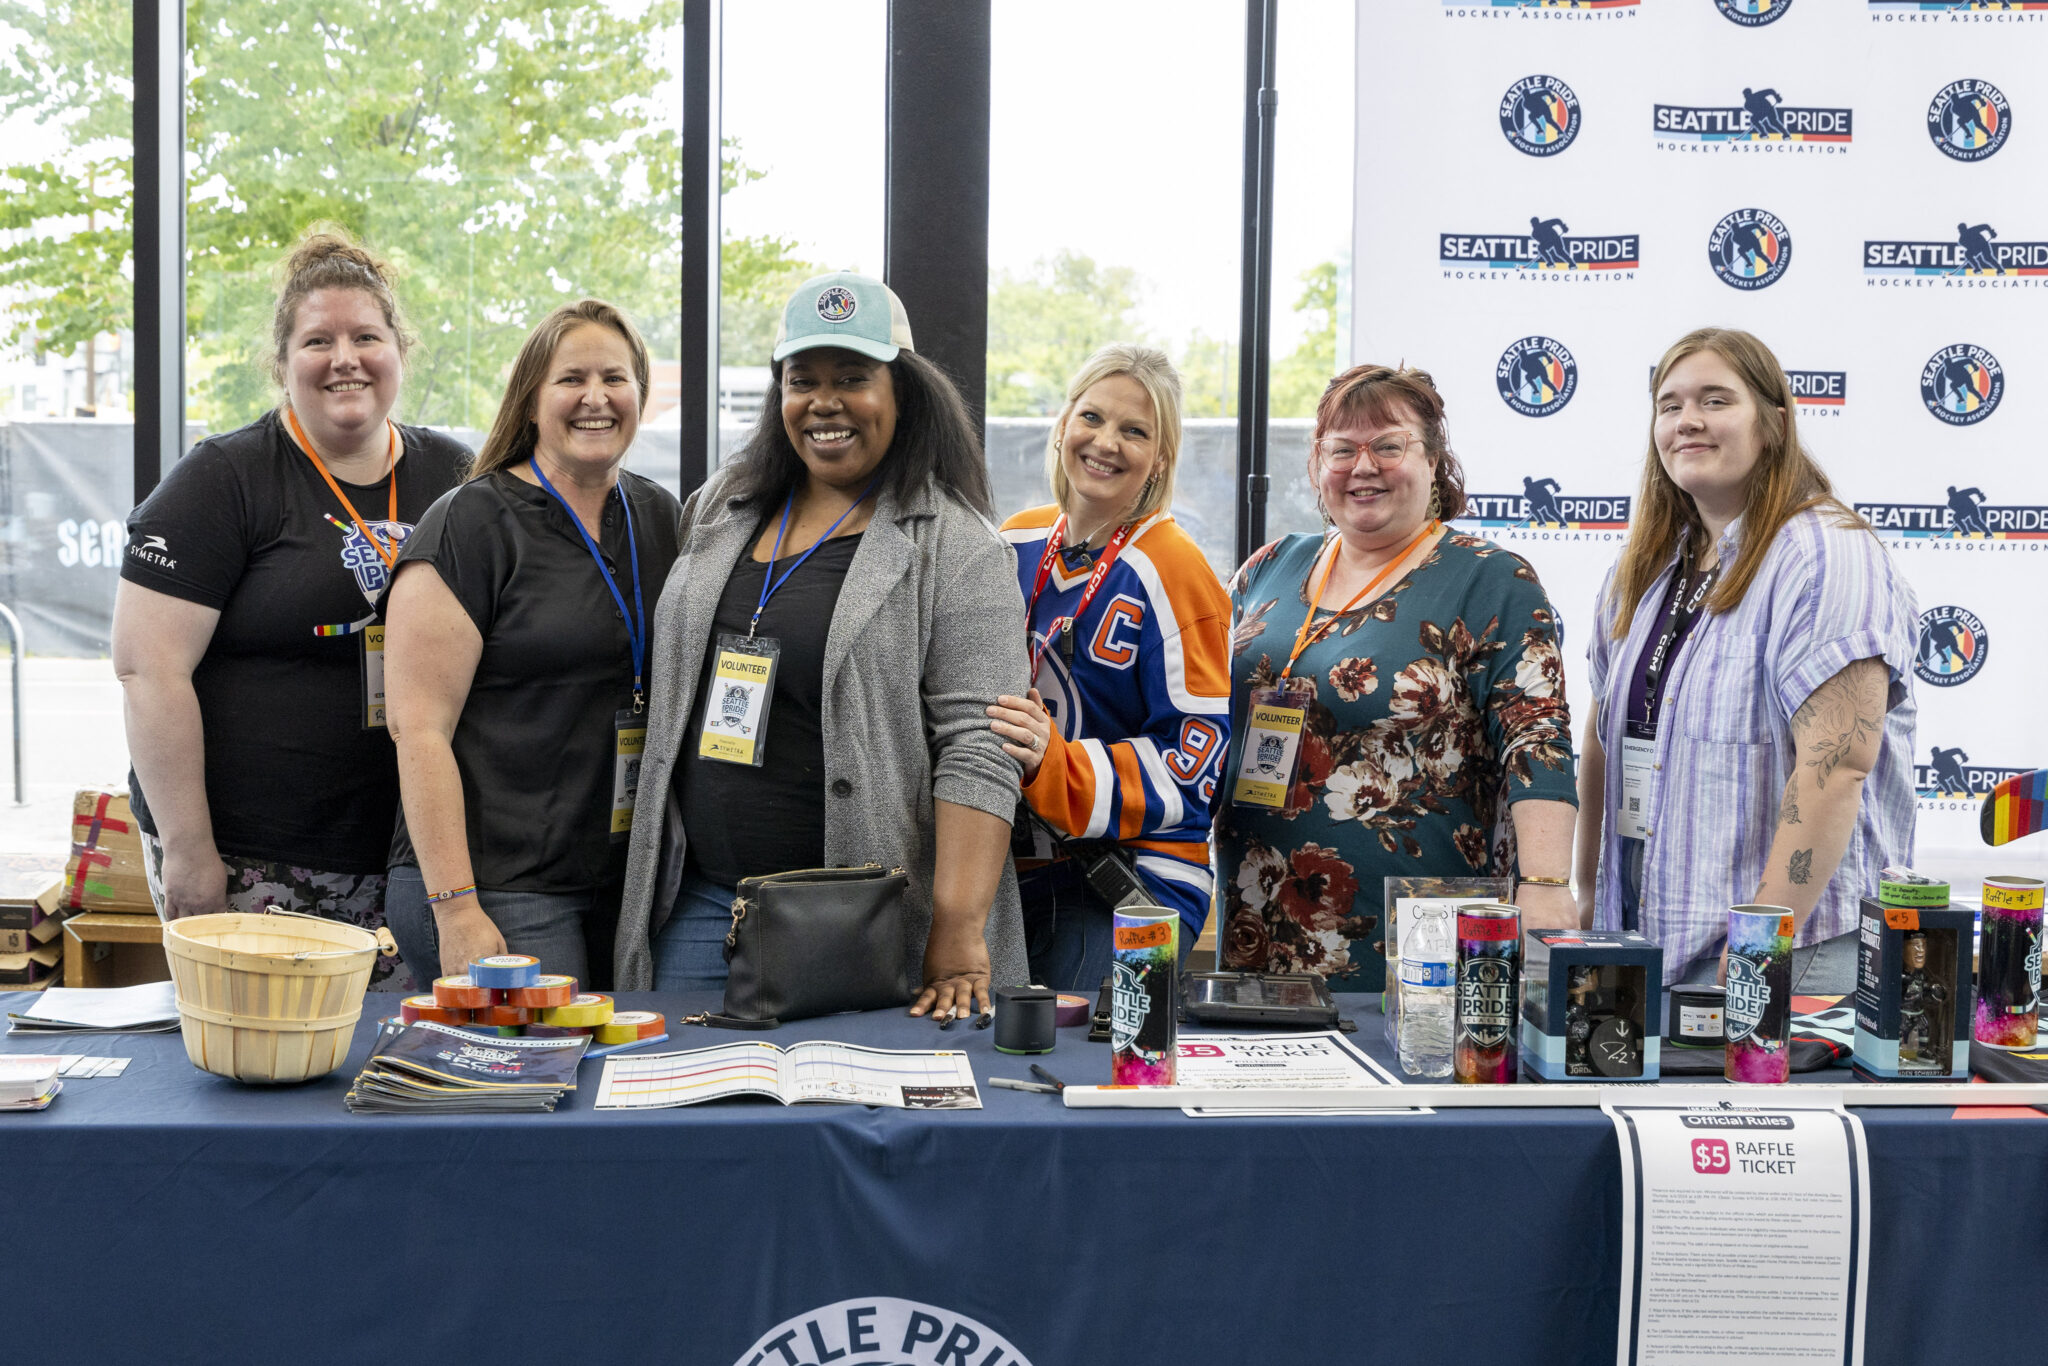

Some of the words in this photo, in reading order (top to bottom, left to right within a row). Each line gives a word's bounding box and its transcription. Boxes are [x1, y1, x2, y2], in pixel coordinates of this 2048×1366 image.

[1446, 9, 1511, 19] HOCKEY
[1521, 9, 1637, 20] ASSOCIATION
[1726, 9, 1757, 24] HOCKEY
[1759, 0, 1789, 24] ASSOCIA
[1872, 14, 1939, 22] HOCKEY
[1951, 14, 2044, 22] ASSOCIATI
[1501, 76, 1542, 118] SEATTLE
[1545, 77, 1578, 109] PRIDE
[1928, 80, 1971, 123] SEATTLE
[1975, 81, 2008, 112] PRIDE
[1657, 108, 1752, 131] SEATTLE
[1784, 111, 1847, 132] PRIDE
[1514, 138, 1544, 154] HOCKEY
[1546, 113, 1577, 153] ASSOCIATION
[1942, 143, 1973, 159] HOCKEY
[1975, 117, 2008, 158] ASSOCIATION
[1658, 142, 1720, 153] HOCKEY
[1731, 145, 1847, 154] ASSOCIATION
[1710, 210, 1752, 252] SEATTLE
[1755, 210, 1788, 241] PRIDE
[1443, 237, 1540, 259] SEATTLE
[1569, 239, 1635, 260] PRIDE
[1867, 244, 1966, 266] SEATTLE
[1997, 246, 2048, 266] PRID
[1443, 271, 1509, 280] HOCKEY
[1519, 272, 1634, 282] ASSOCIATION
[1723, 272, 1754, 288] HOCKEY
[1756, 246, 1788, 287] ASSOCIATION
[1868, 279, 1934, 287] HOCKEY
[1498, 337, 1539, 378] SEATTLE
[1542, 339, 1574, 369] PRIDE
[1922, 345, 1964, 387] SEATTLE
[1968, 346, 2001, 377] PRIDE
[1510, 398, 1540, 414] HOCKEY
[1541, 374, 1574, 414] ASSOCIATION
[1934, 407, 1964, 422] HOCKEY
[1966, 381, 2000, 422] ASSOCIATION
[1464, 497, 1531, 518] ATTLE
[1561, 500, 1626, 520] PRIDE
[1857, 507, 1955, 528] SEATTLE
[1986, 509, 2048, 530] PRIDE
[57, 518, 128, 568] SEA
[1471, 530, 1498, 539] KEY
[1510, 531, 1624, 541] ASSOCIATION
[1883, 541, 1922, 550] CKEY
[1085, 561, 1108, 601] CCM
[1670, 578, 1687, 616] CCM
[1686, 573, 1712, 614] CCM
[1088, 592, 1146, 671] C
[1953, 608, 1986, 639] PRIDE
[1649, 634, 1668, 672] CCM
[1920, 669, 1949, 683] HOCKEY
[1950, 644, 1985, 683] ASSOCIATION
[721, 659, 767, 675] VOLUNTEER
[722, 697, 749, 708] SEATTLE
[1255, 711, 1301, 726] VOLUNTEER
[1258, 746, 1283, 757] SEATTLE
[1918, 802, 1976, 811] ASSOCI
[1984, 887, 2013, 905] Raffle
[1412, 904, 1459, 920] CSH
[1119, 930, 1145, 946] Raffle
[1457, 983, 1512, 999] SEATTL
[1463, 1000, 1512, 1015] PRIDE
[1726, 996, 1758, 1014] RIDE
[1466, 1017, 1509, 1025] CLASSIC
[421, 1023, 525, 1047] TOURNAMENT
[1229, 1043, 1326, 1051] RAFFLE
[1687, 1116, 1744, 1126] Official
[1748, 1116, 1788, 1126] Rules
[1695, 1143, 1727, 1170] $5
[1735, 1142, 1796, 1157] RAFFLE
[1738, 1159, 1796, 1175] TICKET
